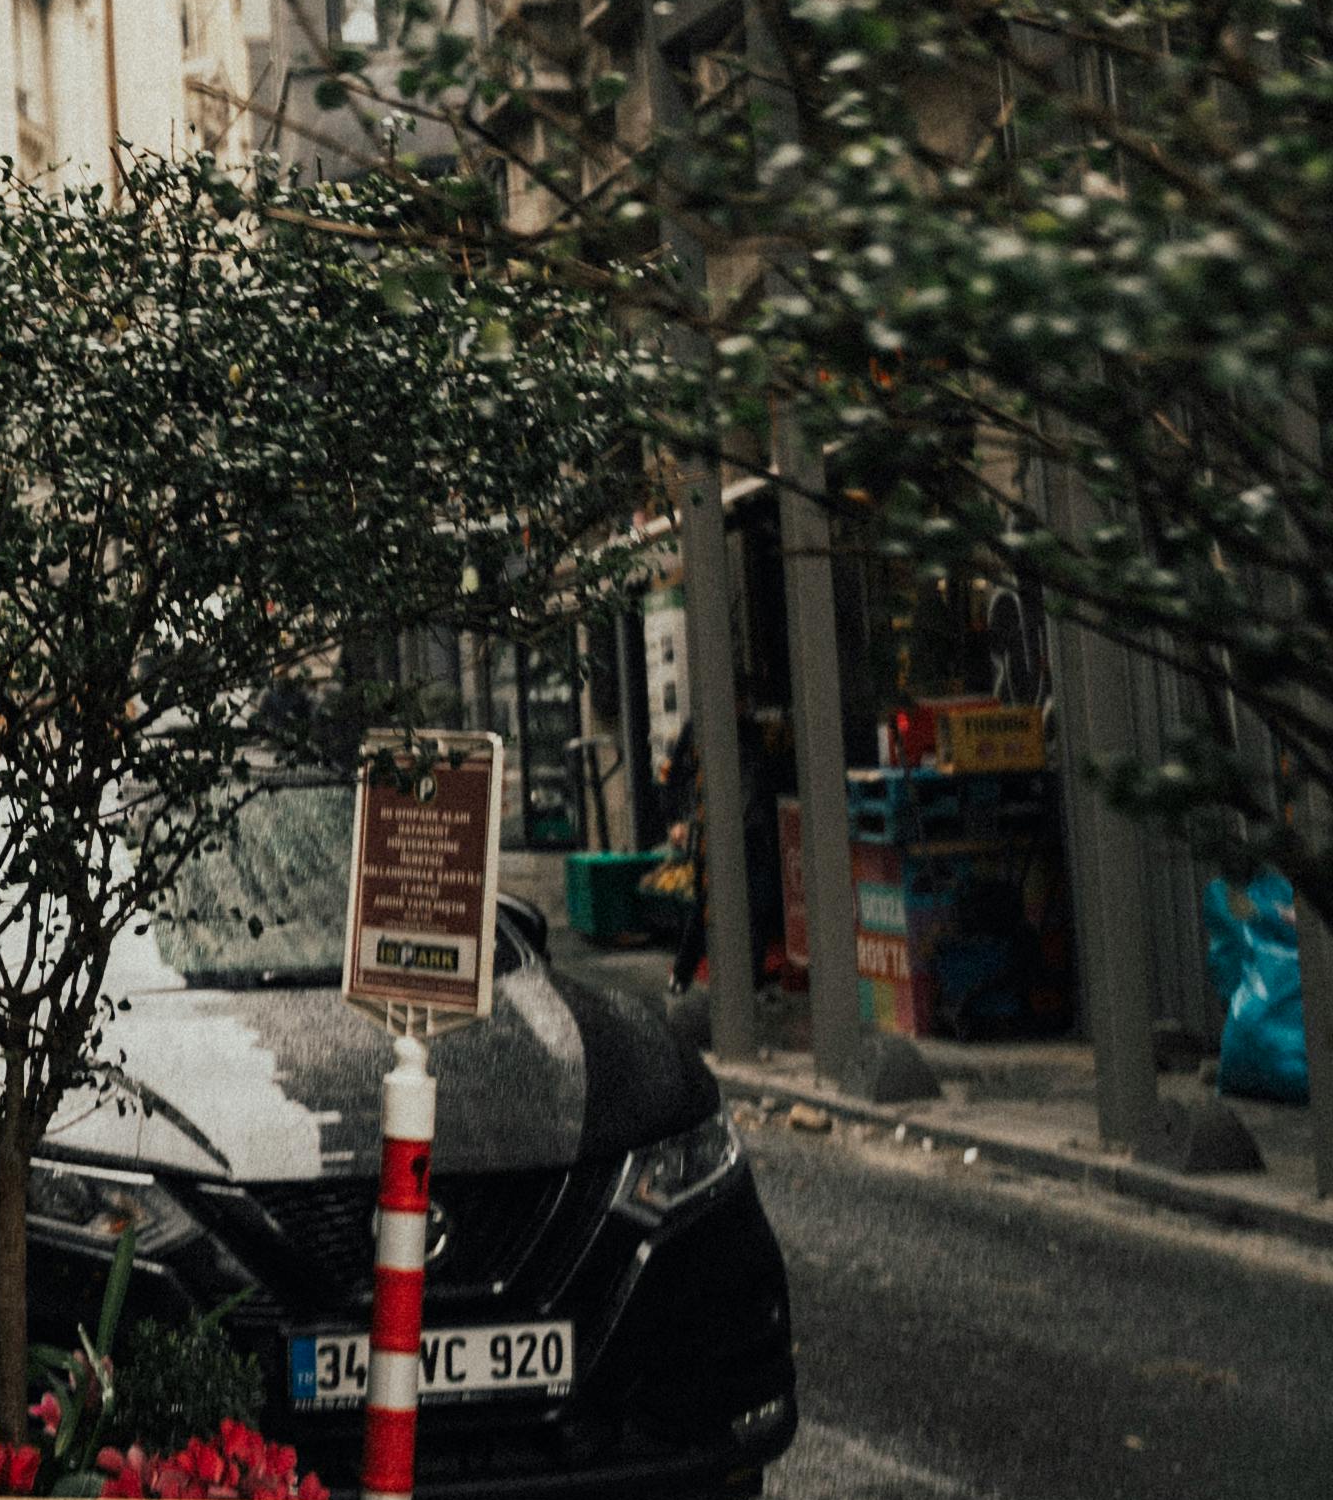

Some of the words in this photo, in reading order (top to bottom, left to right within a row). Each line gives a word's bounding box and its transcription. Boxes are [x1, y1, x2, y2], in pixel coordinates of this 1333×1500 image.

[317, 1342, 367, 1390] 34
[419, 1336, 467, 1384] VC
[489, 1330, 564, 1380] 920
